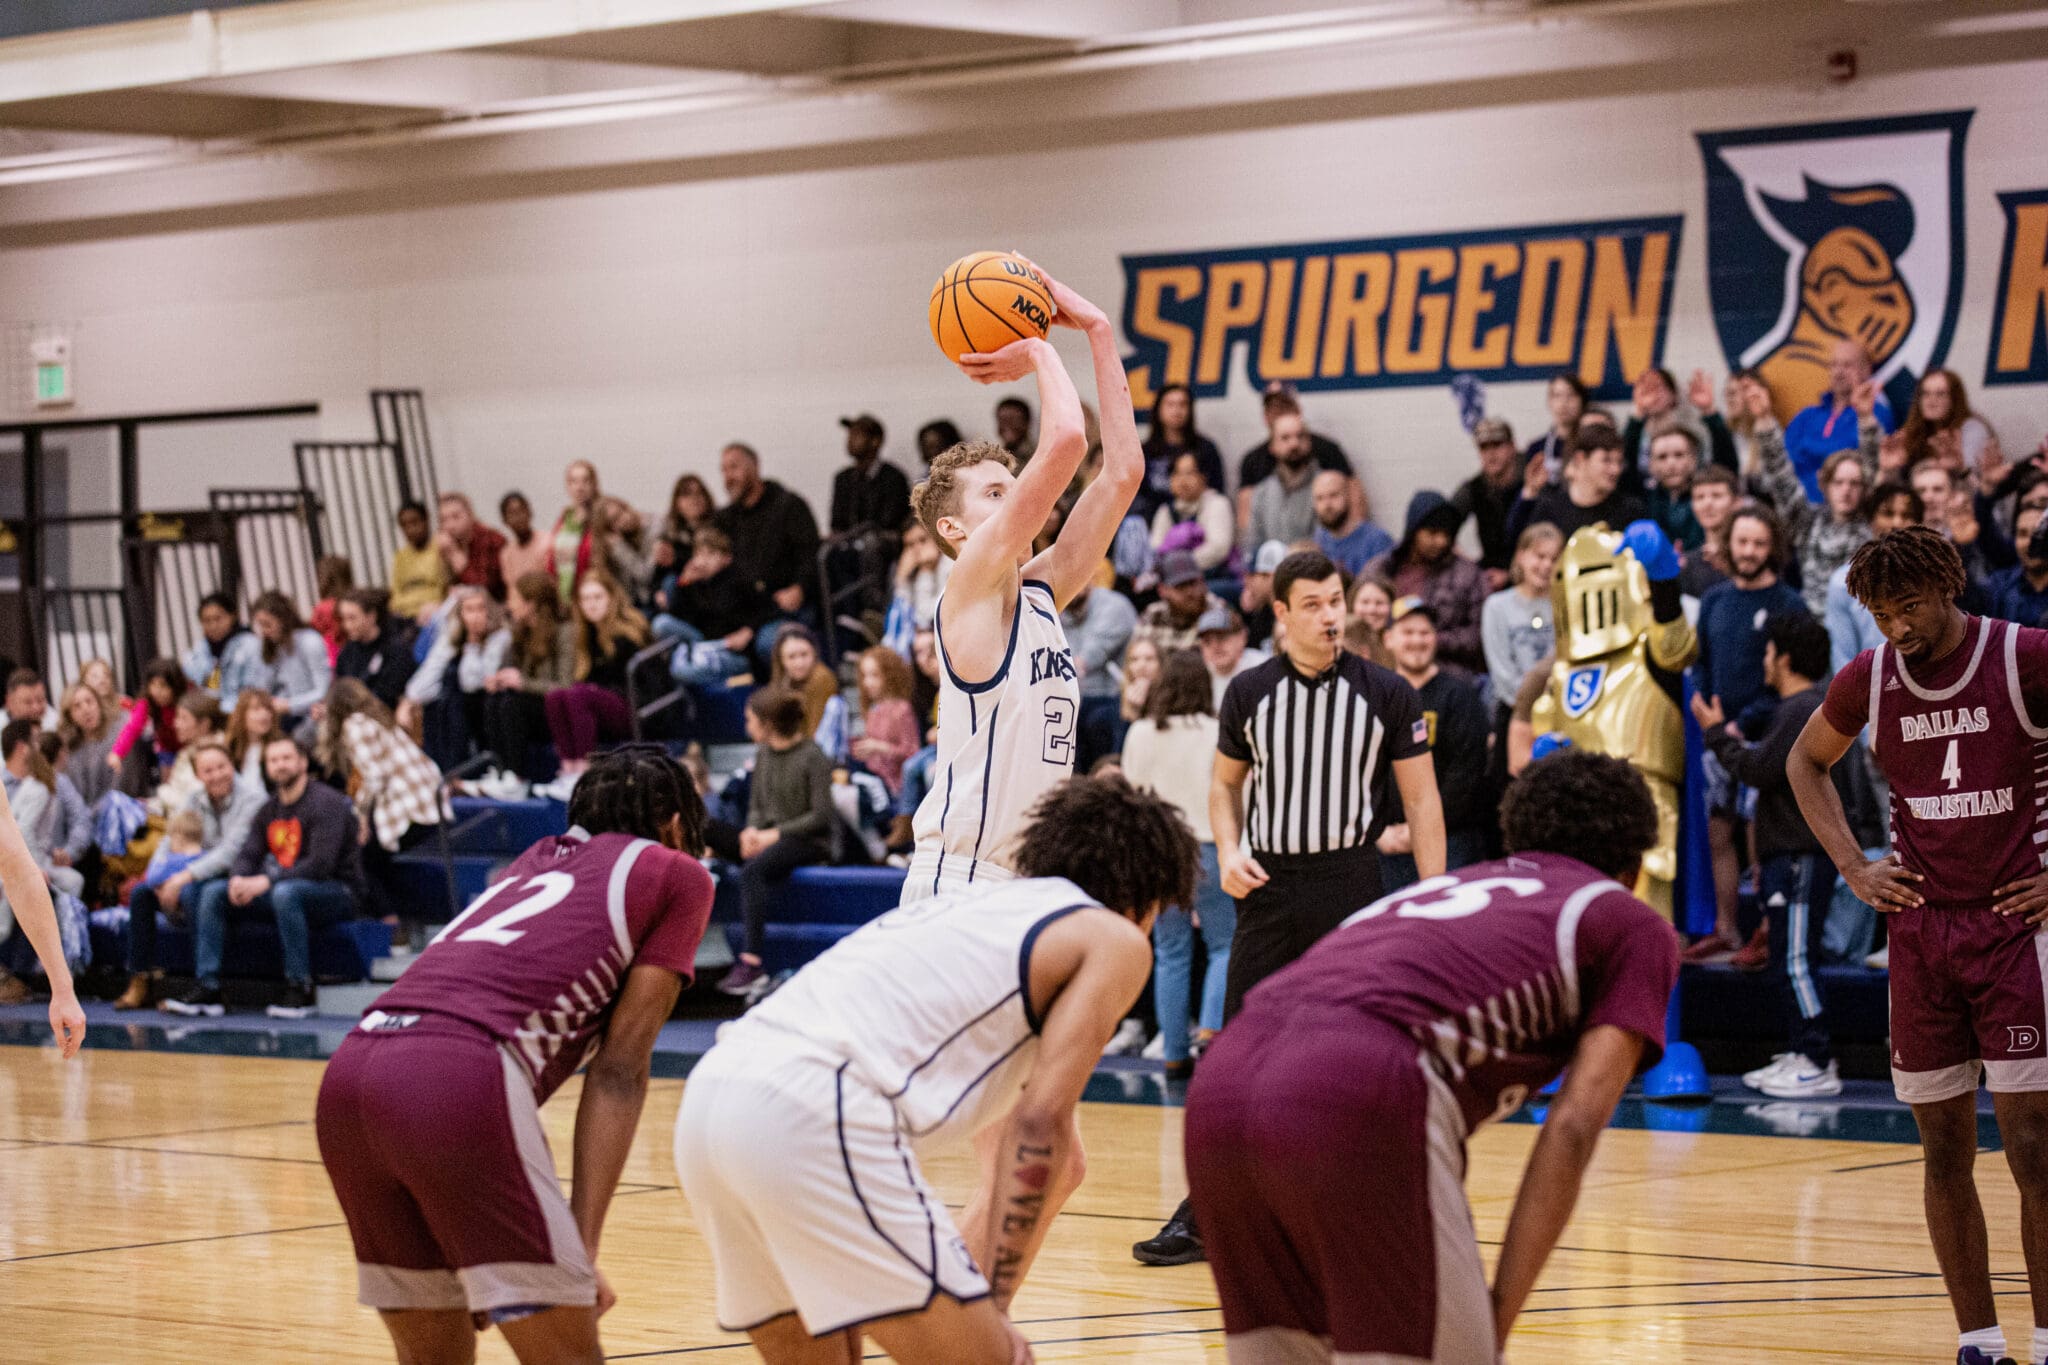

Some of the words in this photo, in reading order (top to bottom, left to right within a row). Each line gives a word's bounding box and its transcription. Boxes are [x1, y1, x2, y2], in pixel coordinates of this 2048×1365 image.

[1011, 294, 1050, 335] NCAA
[1127, 232, 1670, 409] SPURGEON
[1568, 671, 1593, 706] S
[1042, 695, 1075, 766] 2
[1900, 706, 1990, 742] DALLAS
[1941, 739, 1961, 790] 4
[428, 870, 575, 946] 12
[2007, 1025, 2040, 1052] D
